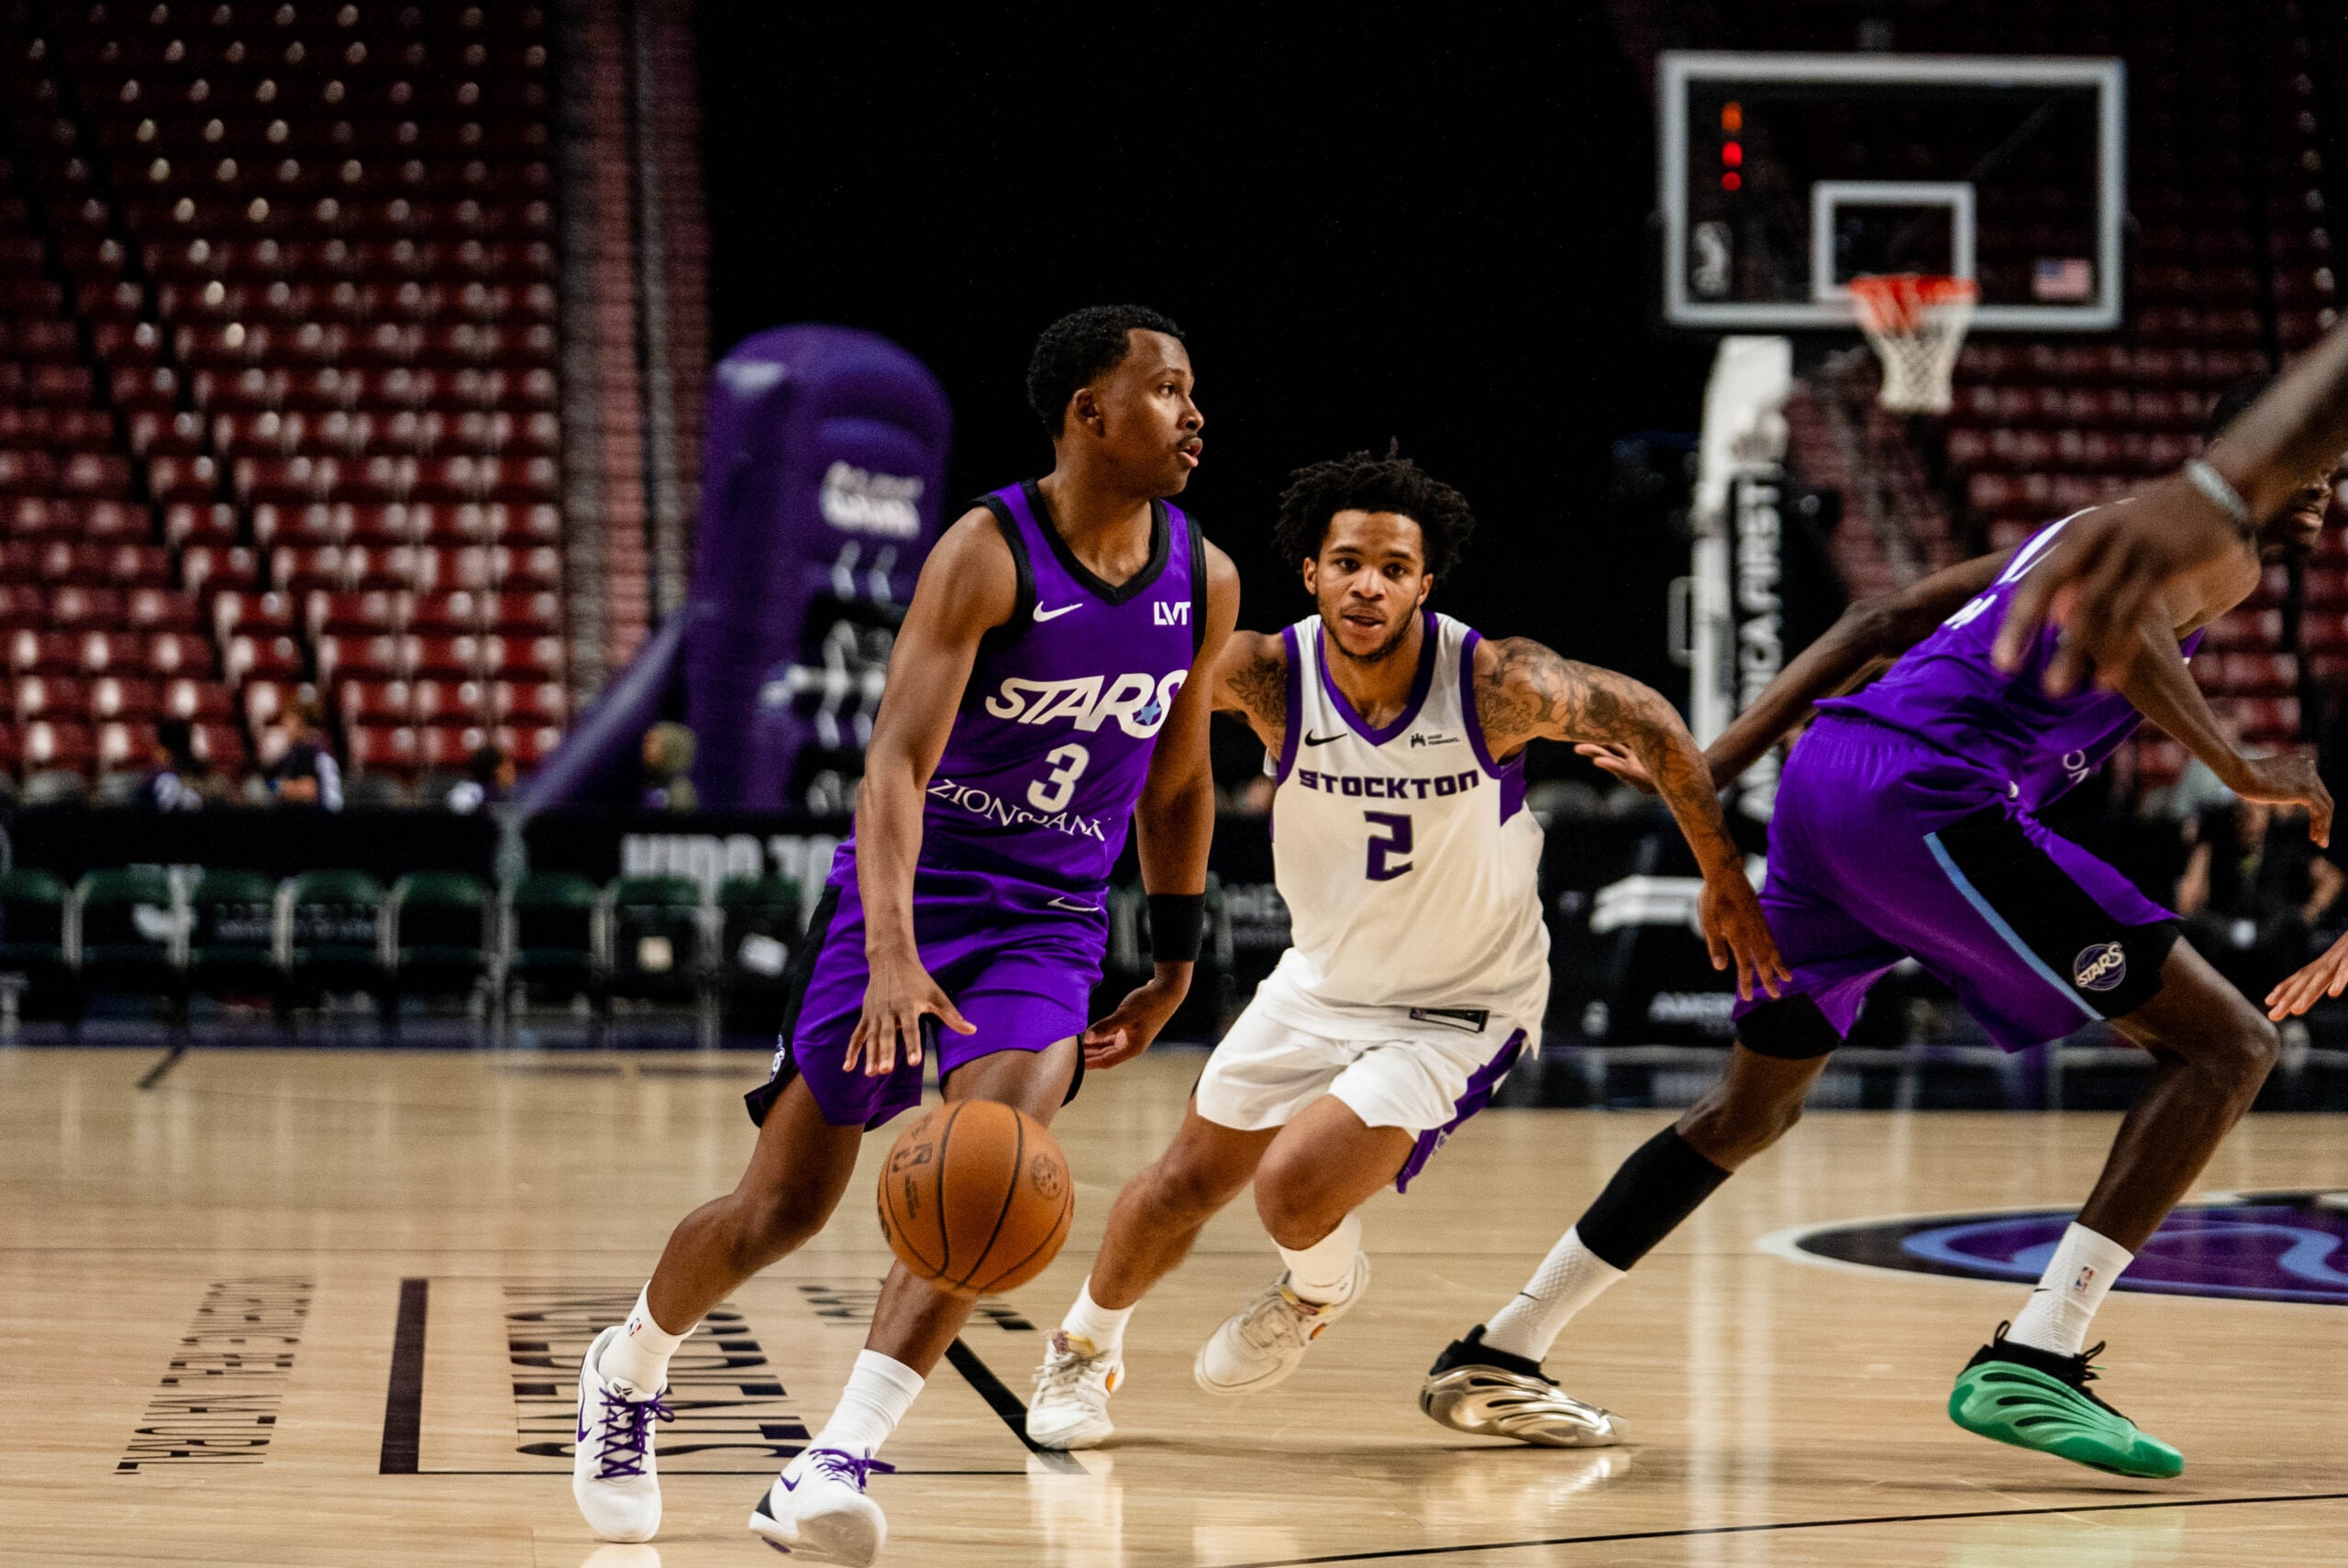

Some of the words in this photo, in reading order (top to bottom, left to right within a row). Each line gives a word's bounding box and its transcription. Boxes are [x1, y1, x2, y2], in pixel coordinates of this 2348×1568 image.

[1737, 483, 1782, 611] FIRST
[1153, 601, 1191, 625] LVT
[985, 669, 1189, 739] STARS
[1026, 743, 1090, 813] 3
[1298, 768, 1479, 799] STOCKTON
[1363, 811, 1413, 881] 2
[2076, 942, 2123, 988] STARS
[112, 1394, 283, 1474] NATURAL.
